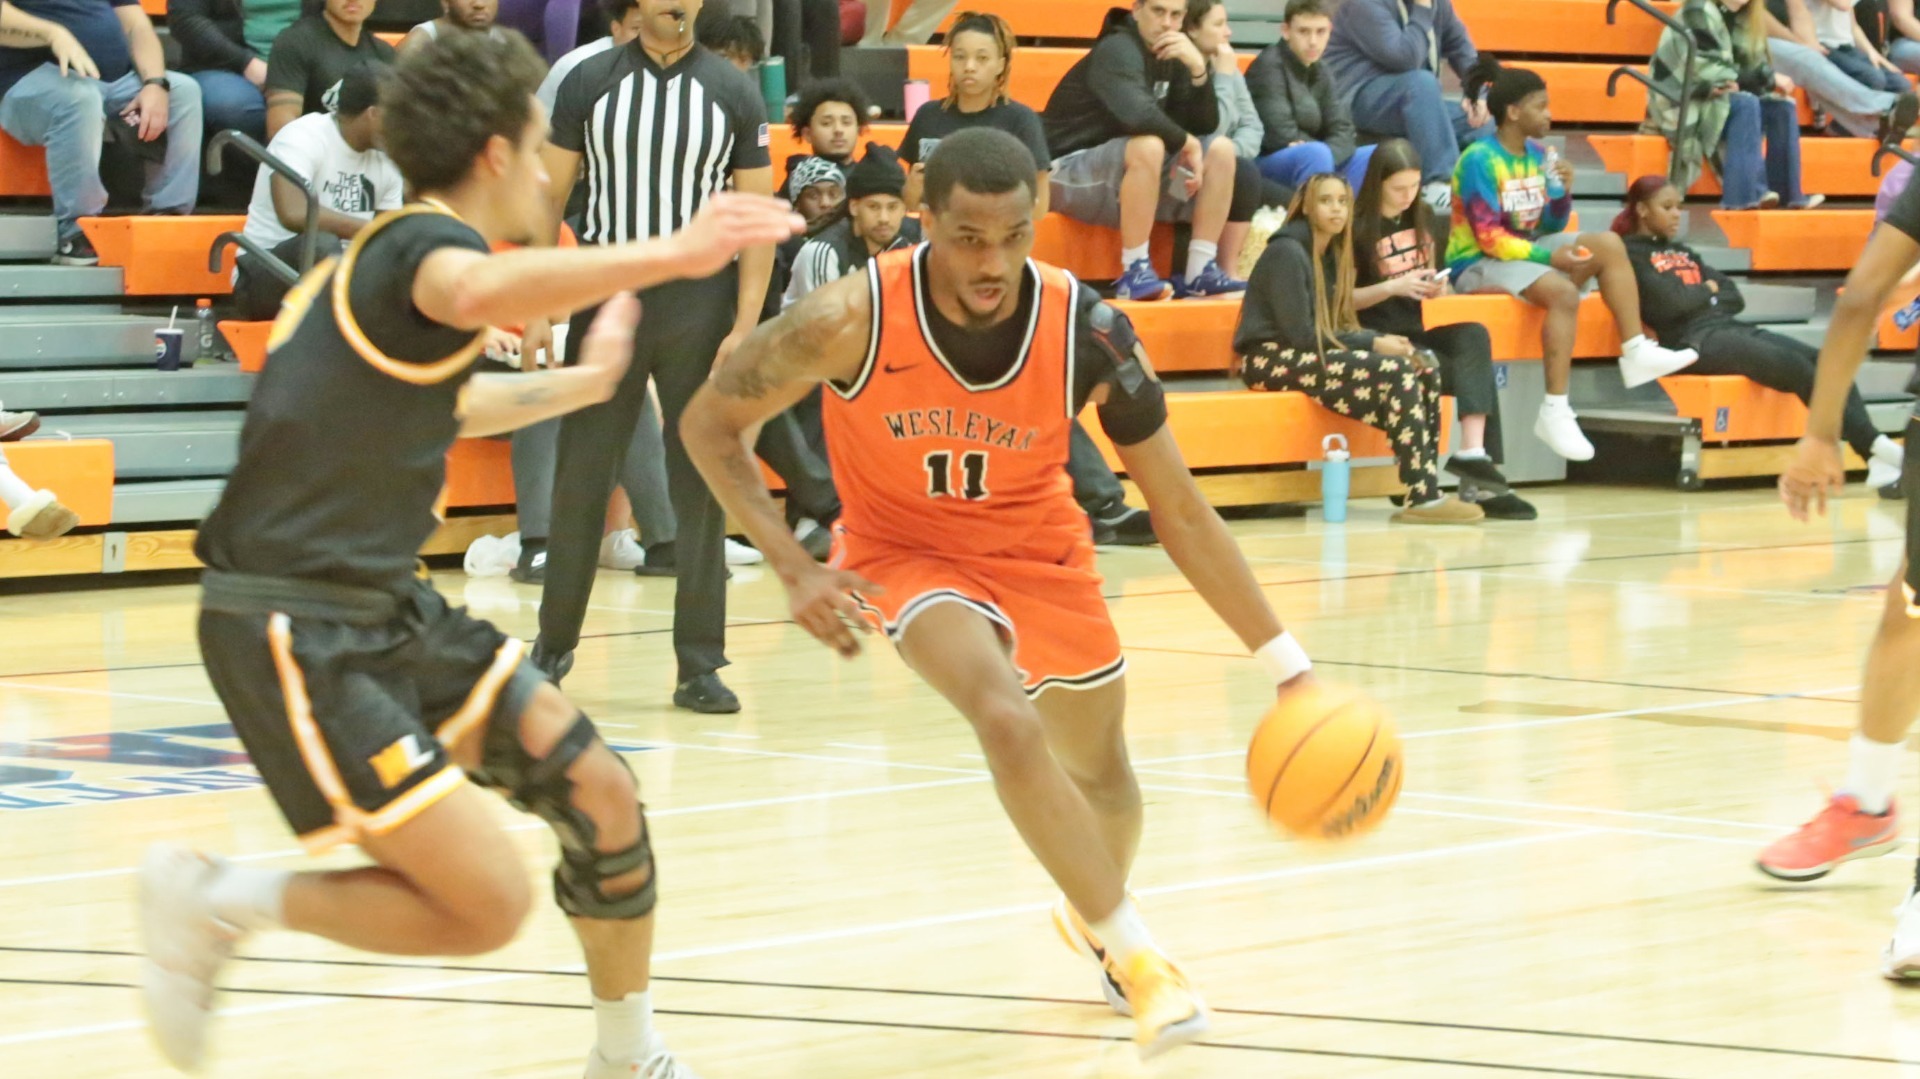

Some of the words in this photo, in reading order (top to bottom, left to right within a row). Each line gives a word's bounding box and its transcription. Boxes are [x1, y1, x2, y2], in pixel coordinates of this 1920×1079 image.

[337, 171, 358, 187] THE
[323, 180, 360, 198] NRTH
[334, 198, 360, 212] ACE
[200, 334, 213, 348] G
[923, 449, 989, 501] 11
